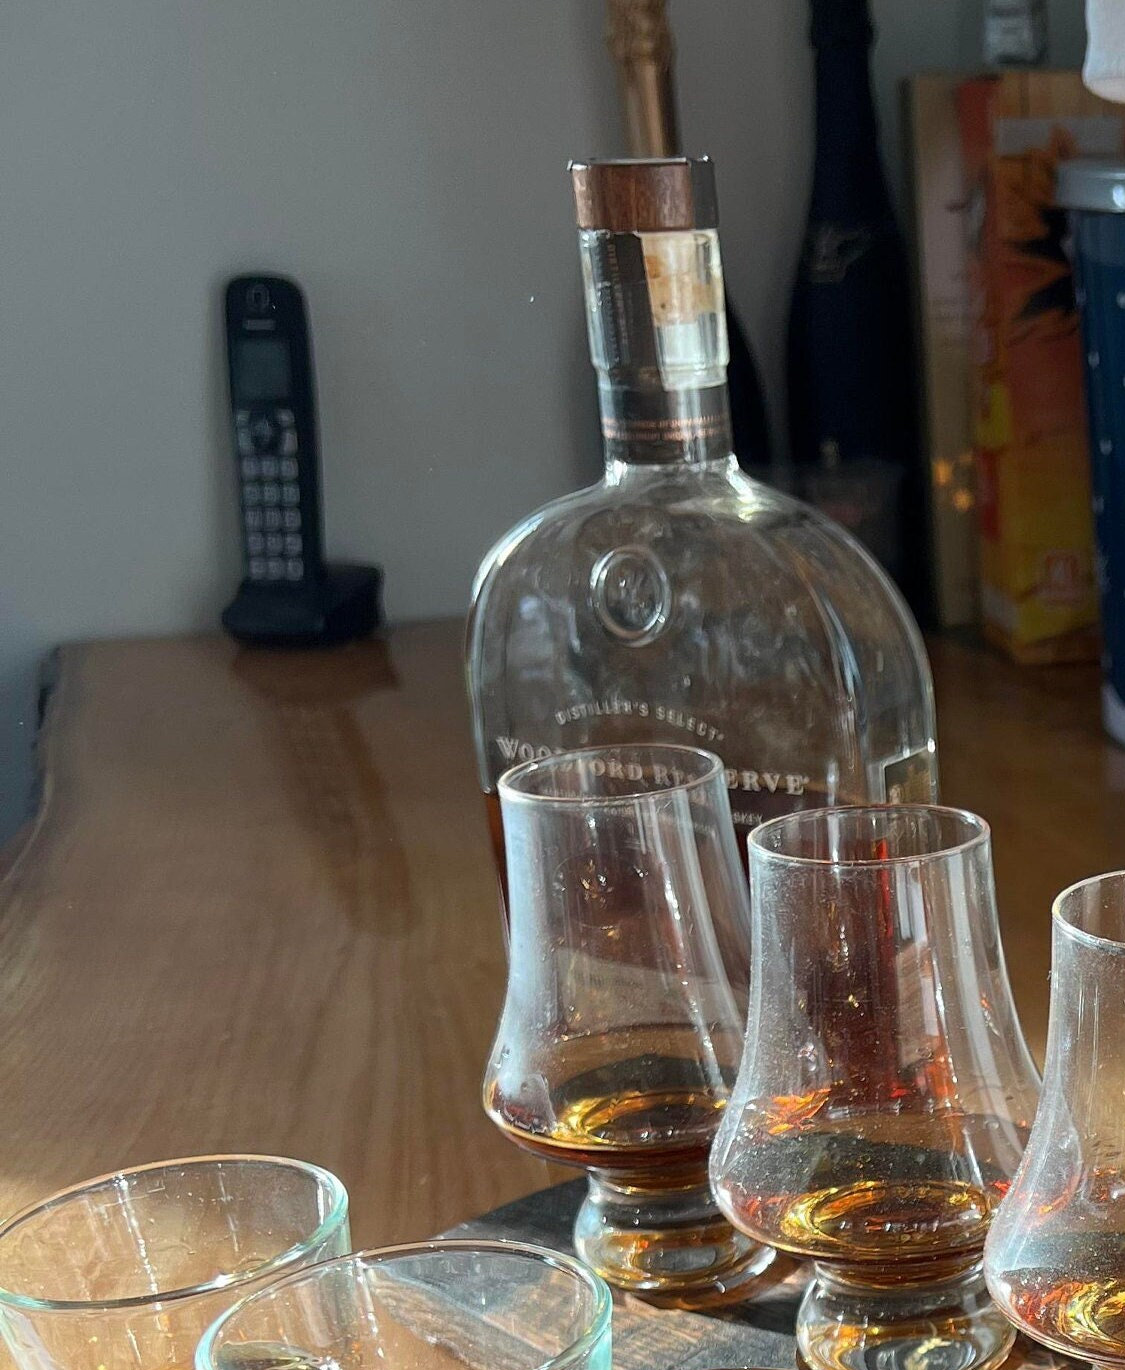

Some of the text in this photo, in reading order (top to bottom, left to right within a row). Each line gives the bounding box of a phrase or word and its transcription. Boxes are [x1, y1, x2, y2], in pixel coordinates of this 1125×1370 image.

[555, 700, 720, 742] DISTILLER'S SELECT
[496, 737, 805, 796] WOOORD REERVE
[732, 811, 764, 826] SKEY
